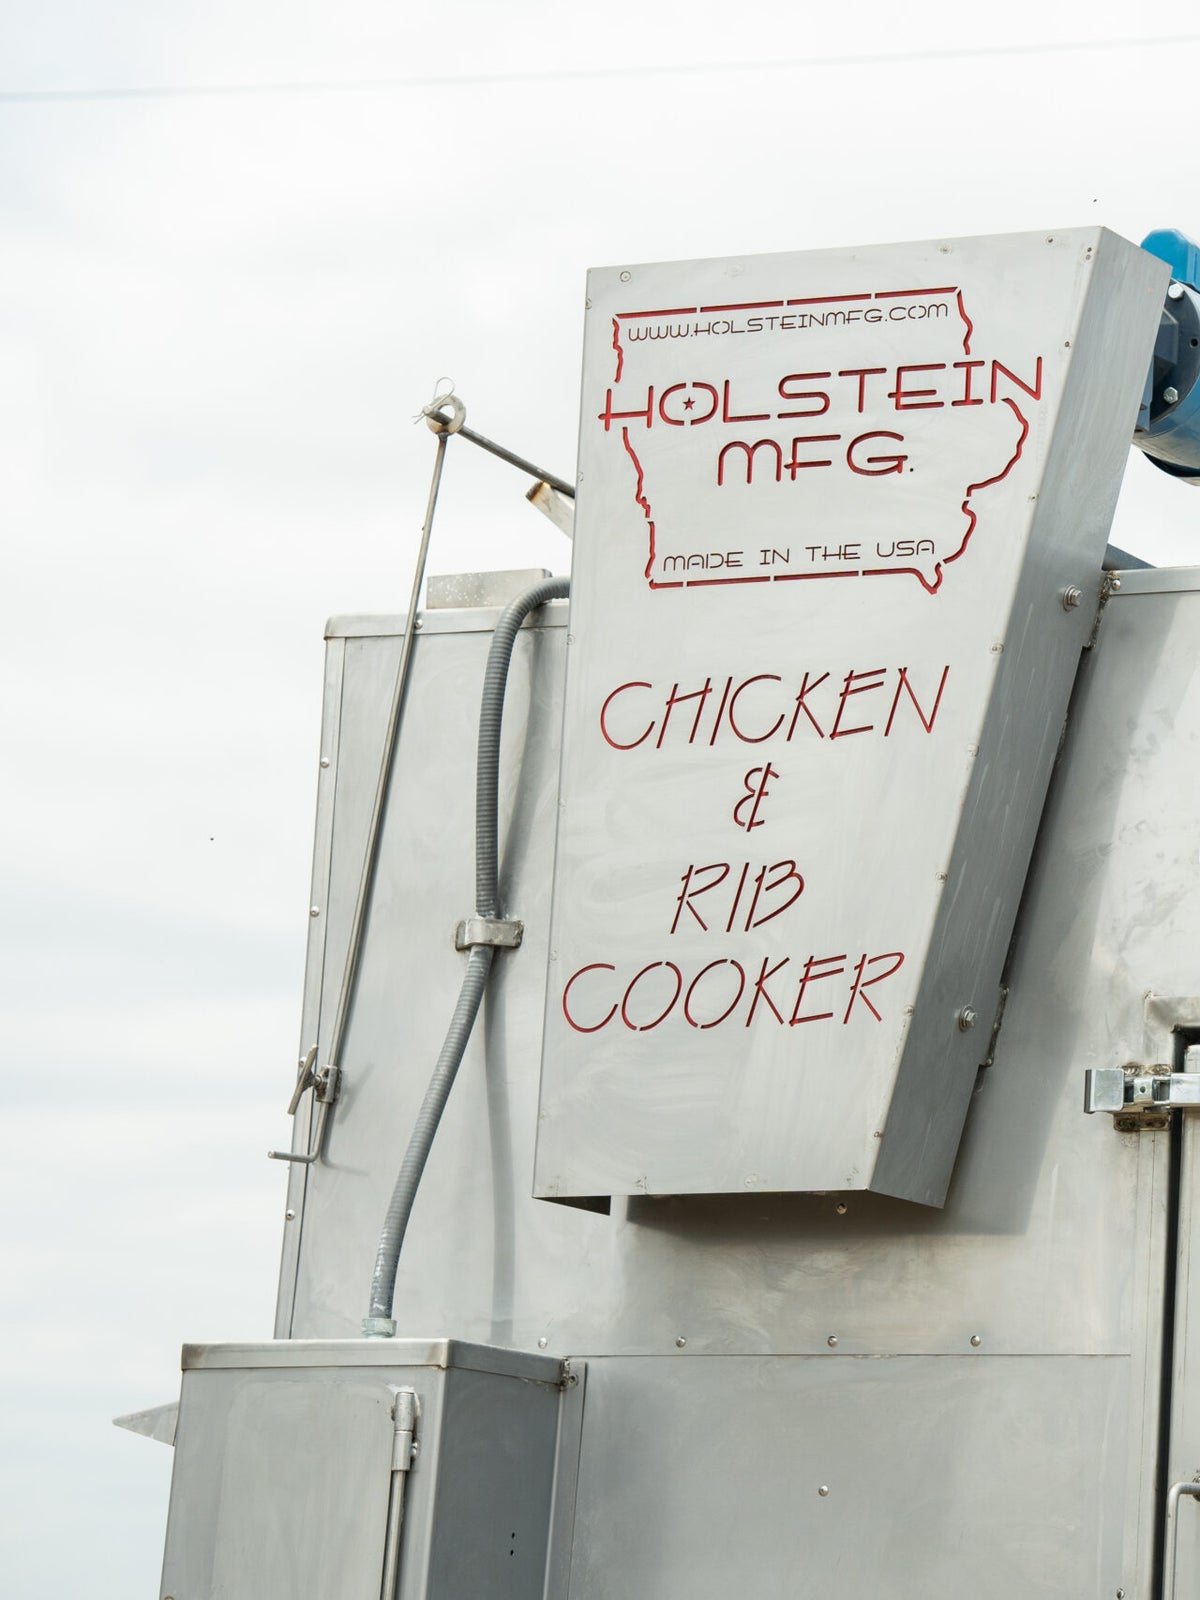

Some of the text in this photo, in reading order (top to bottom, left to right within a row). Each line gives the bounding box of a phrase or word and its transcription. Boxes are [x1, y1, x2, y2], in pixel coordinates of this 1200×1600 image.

[598, 357, 1042, 431] HOLSTEIN
[718, 431, 914, 486] MFG.
[663, 539, 935, 572] MADE IN THE USA
[600, 665, 949, 749] CHICKEN
[733, 762, 779, 832] &
[670, 860, 804, 934] RIB
[563, 952, 905, 1033] COOKER
